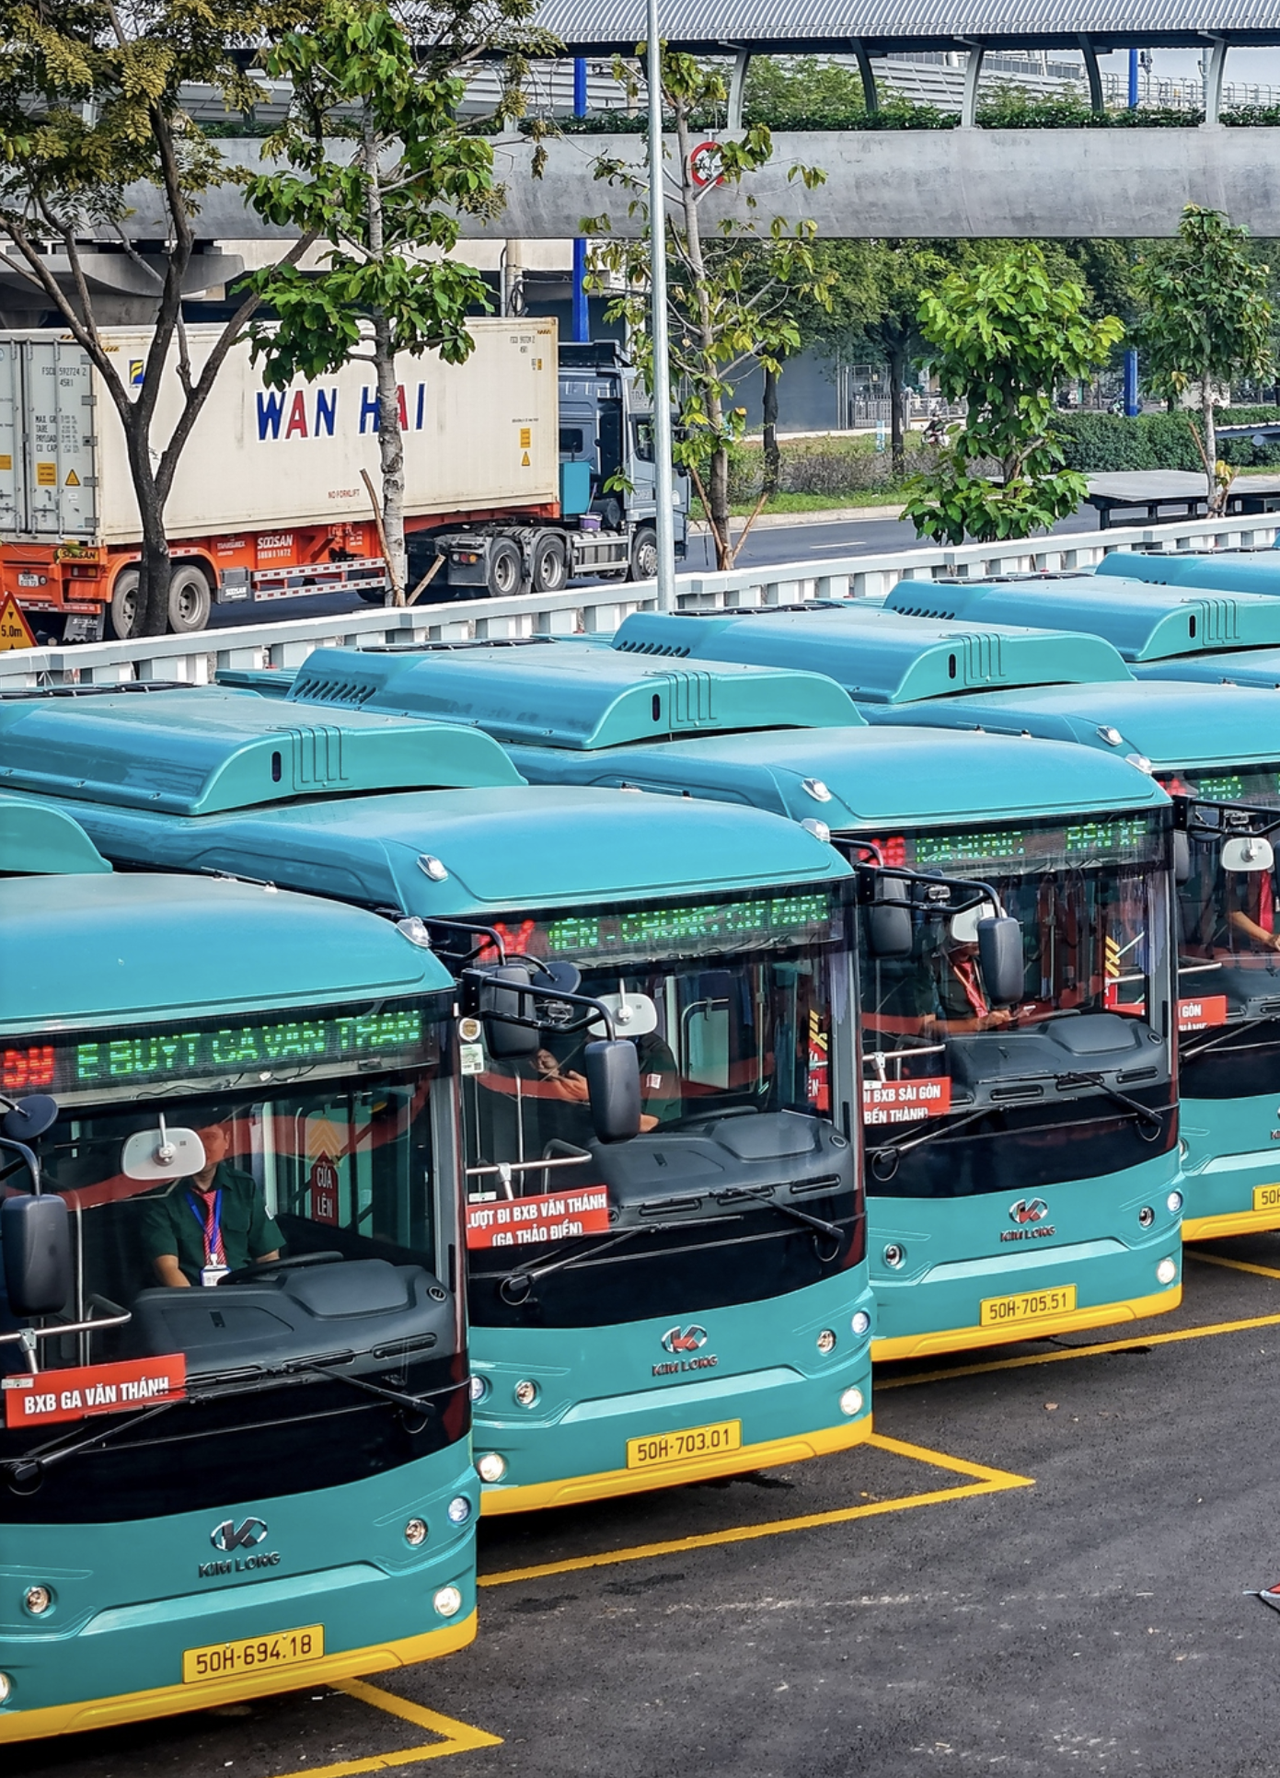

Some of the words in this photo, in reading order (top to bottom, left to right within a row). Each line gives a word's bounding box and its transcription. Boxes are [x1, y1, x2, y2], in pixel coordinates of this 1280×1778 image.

[256, 387, 338, 441] WAN
[257, 534, 294, 549] SOOSAN
[873, 1088, 896, 1103] BXB
[898, 1084, 917, 1101] SÀI
[918, 1082, 942, 1100] GÒN
[316, 1160, 333, 1190] CỬA
[317, 1192, 333, 1219] LÊN
[497, 1207, 511, 1225] ĐI
[513, 1204, 538, 1222] BXB
[540, 1198, 566, 1218] VĂN
[567, 1192, 607, 1213] THÁNH
[516, 1223, 548, 1245] THẢO
[1000, 1228, 1024, 1243] KIM
[1026, 1224, 1057, 1240] LONG
[989, 1292, 1068, 1319] 50H-705.51
[652, 1361, 679, 1378] KIM
[681, 1354, 719, 1373] LONG
[24, 1393, 57, 1415] BXB
[60, 1390, 83, 1410] GA
[85, 1383, 117, 1407] VĂN
[119, 1375, 170, 1401] THÁNH
[637, 1427, 731, 1462] 50H-703.01
[198, 1559, 232, 1580] KIM
[234, 1551, 282, 1573] LONG
[195, 1634, 314, 1676] 50H-694.18
